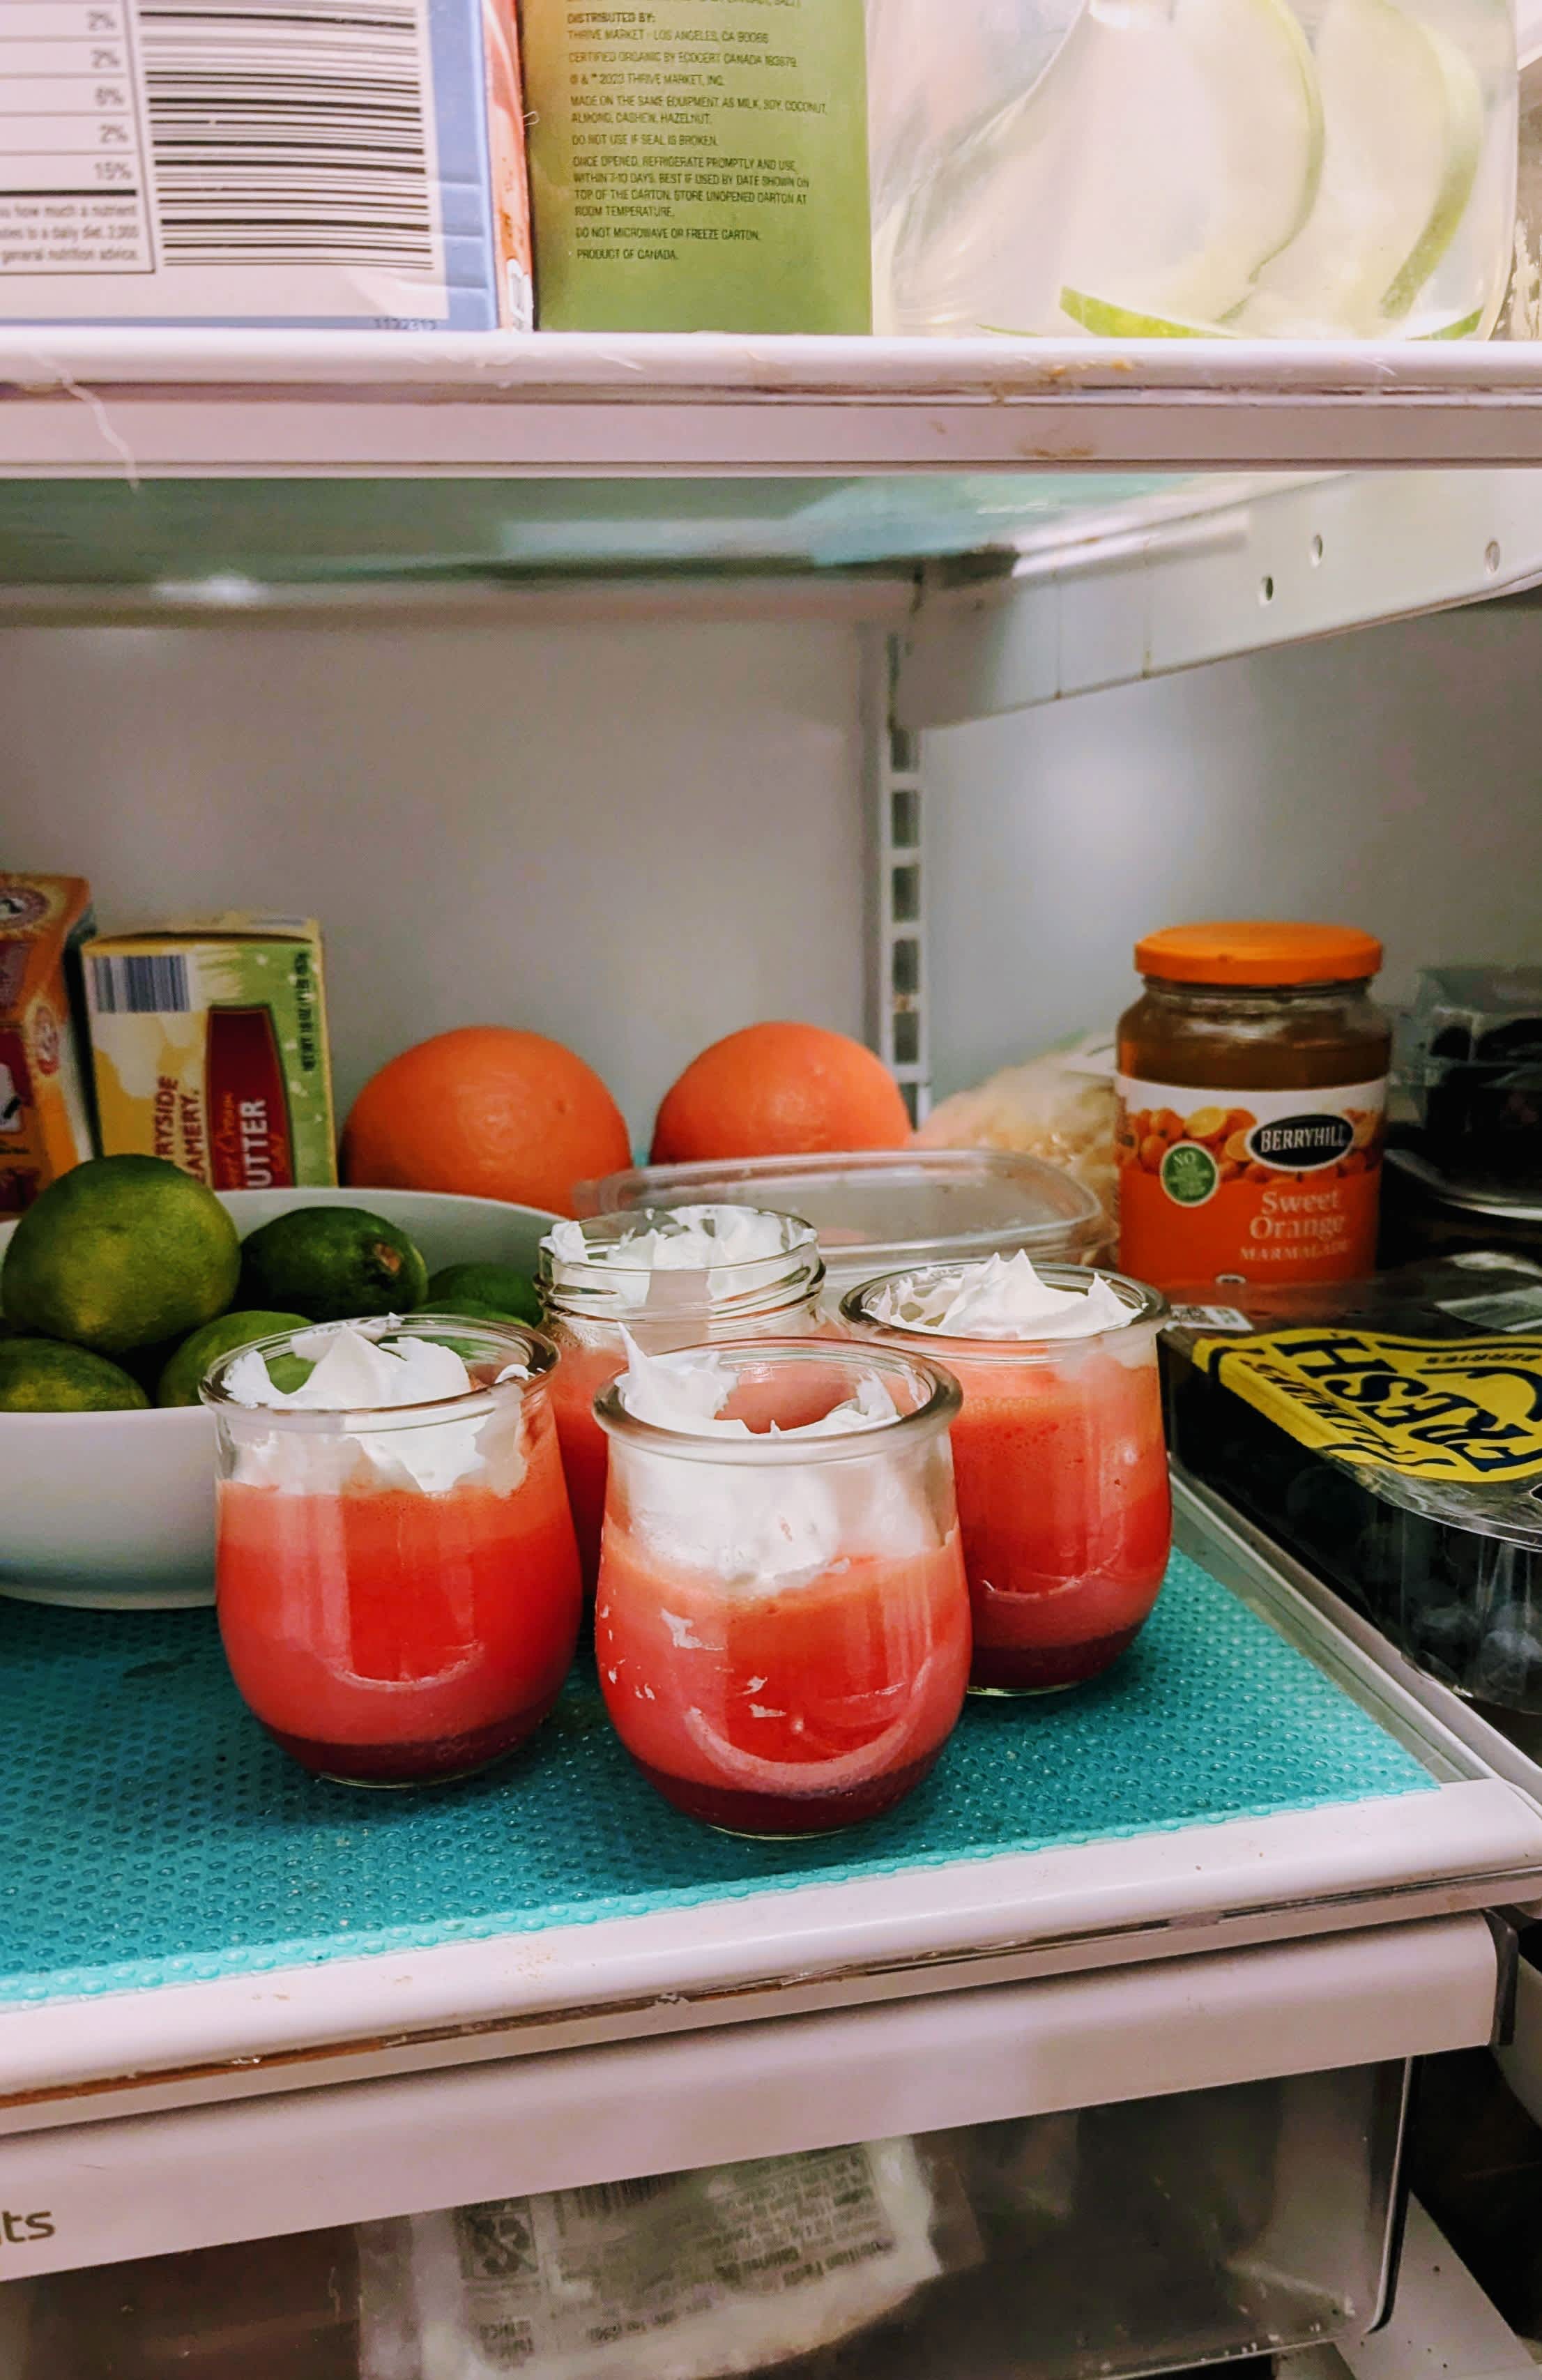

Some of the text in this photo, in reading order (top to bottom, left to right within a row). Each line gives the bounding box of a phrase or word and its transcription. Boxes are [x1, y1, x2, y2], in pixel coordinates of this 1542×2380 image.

[567, 12, 635, 24] DISTRIBUTED
[567, 29, 602, 40] THRIVE
[604, 29, 644, 40] MARKET
[653, 29, 672, 41] LOS
[722, 31, 734, 43] CA
[568, 52, 616, 63] CERTIFIED
[619, 52, 662, 63] ORGANIC
[664, 52, 675, 63] BY
[724, 53, 762, 65] CANADA
[627, 73, 662, 85] THRIVE
[570, 96, 597, 106] MADE
[600, 96, 613, 106] ON
[617, 96, 636, 106] THE
[637, 96, 663, 107] SAME
[666, 96, 719, 108] EQUIPMENT
[722, 97, 734, 108] AS
[572, 134, 586, 146] DO
[588, 134, 607, 146] NOT
[610, 134, 628, 146] USE
[630, 135, 638, 146] IF
[640, 135, 664, 146] SEAL
[667, 135, 677, 146] IS
[573, 155, 598, 167] ONCE
[642, 155, 704, 168] REFRIGERATE
[706, 157, 755, 169] PROMPTLY
[757, 159, 777, 171] AND
[574, 173, 607, 184] WITHIN
[659, 173, 682, 185] BEST
[685, 174, 692, 184] IF
[694, 174, 719, 185] USED
[722, 174, 733, 185] BY
[736, 175, 760, 186] DATE
[761, 176, 795, 188] SHOWN
[796, 177, 809, 188] ON
[574, 190, 593, 200] TOP
[595, 190, 609, 200] OF
[610, 190, 628, 200] THE
[673, 190, 703, 201] STORE
[706, 190, 756, 203] UNOPENED
[757, 192, 794, 204] CARTON
[795, 194, 807, 205] AT
[574, 206, 603, 217] ROOM
[575, 227, 589, 238] DO
[591, 227, 611, 238] NOT
[613, 227, 669, 238] MICROWAVE
[671, 228, 684, 239] OR
[686, 228, 719, 240] FREEZE
[577, 249, 620, 260] PRODUCT
[623, 249, 635, 260] OF
[240, 1098, 273, 1187] UTTER
[1260, 1124, 1345, 1153] BERRYHILL
[1261, 1187, 1340, 1216] Sweet
[1249, 1215, 1346, 1242] Orange
[0, 2209, 56, 2245] ts
